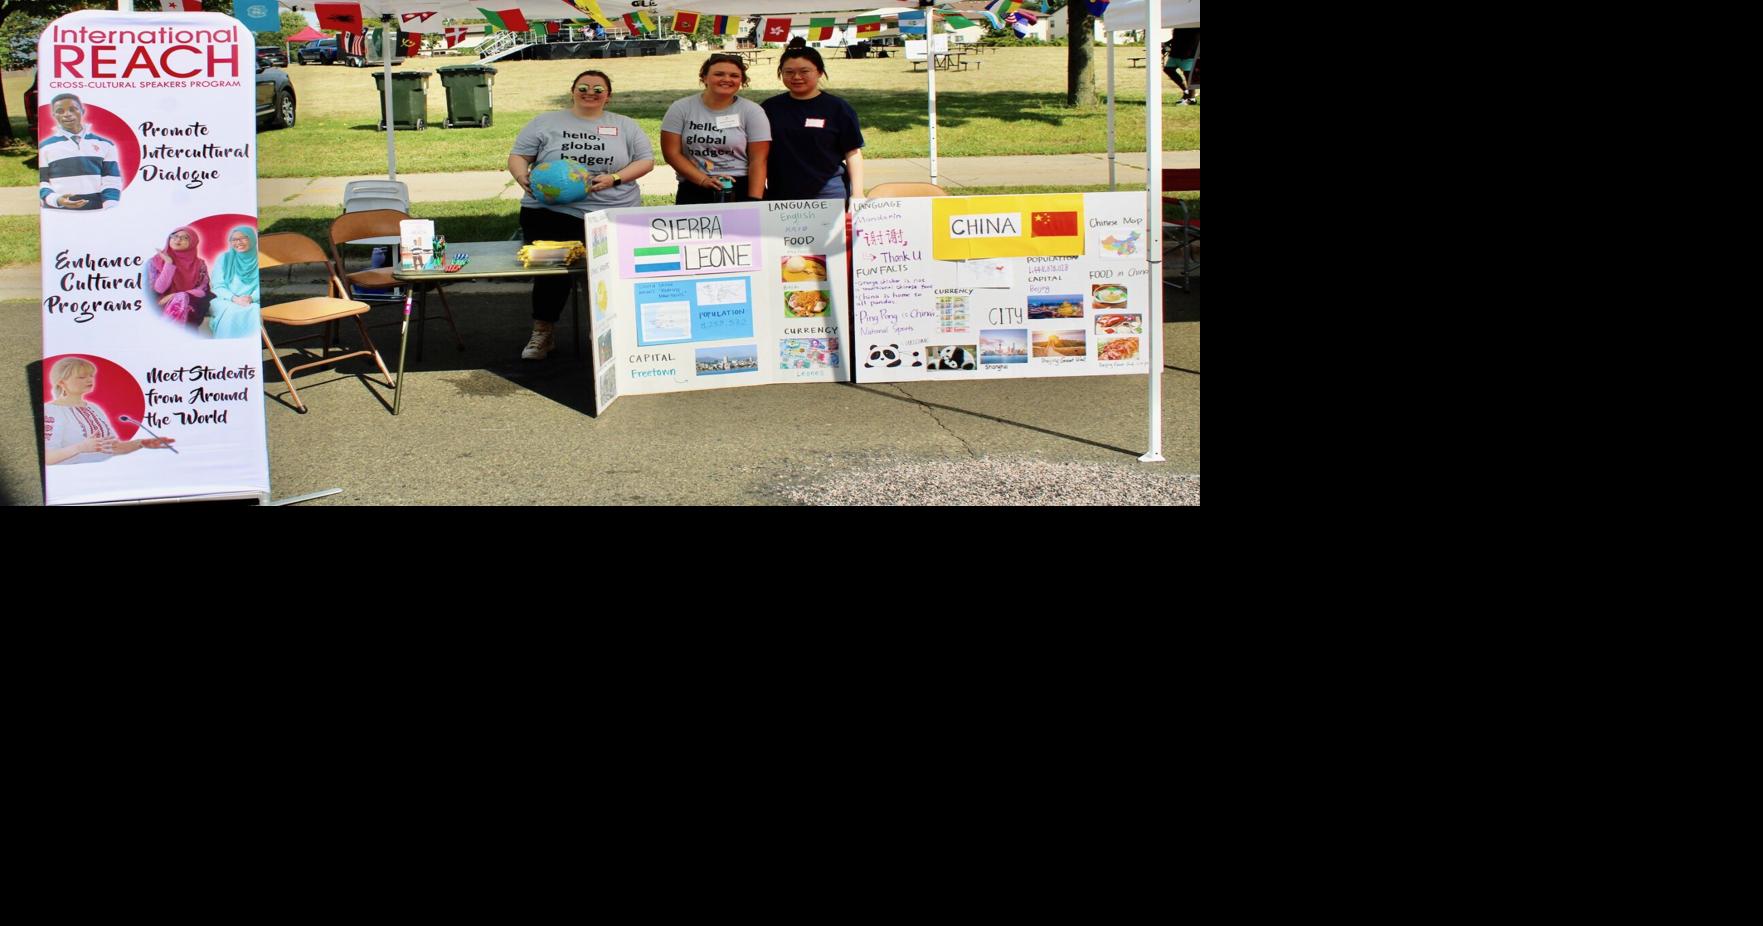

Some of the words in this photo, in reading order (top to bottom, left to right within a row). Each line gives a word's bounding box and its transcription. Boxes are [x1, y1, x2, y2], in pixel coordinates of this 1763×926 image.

[53, 26, 237, 44] International
[53, 45, 239, 78] REACH
[139, 122, 209, 137] Promote
[563, 131, 601, 141] hello,
[561, 142, 605, 151] global
[687, 134, 726, 145] global
[142, 144, 250, 160] Intercultural
[140, 165, 219, 189] Dialogue
[768, 201, 829, 212] LANGUAGE
[853, 200, 903, 212] LANGUAGE
[651, 215, 723, 242] SIERRA
[951, 215, 1017, 236] CHINA
[1089, 217, 1118, 228] Chinese
[1123, 217, 1143, 225] Map
[783, 235, 815, 247] FOOD
[55, 249, 143, 271] Enhance
[684, 243, 752, 271] LEONE
[880, 250, 911, 263] Thank
[912, 250, 922, 261] U
[856, 267, 878, 279] FUN
[880, 265, 909, 275] FACTS
[1089, 269, 1113, 280] FOOD
[60, 272, 143, 292] Cultural
[934, 287, 973, 296] CURRENCY
[44, 295, 143, 323] Programs
[699, 308, 745, 320] POPULATION
[988, 307, 1023, 326] CITY
[784, 326, 839, 335] CURRENCY
[629, 353, 676, 363] CAPITAL
[146, 367, 187, 383] Meet
[188, 364, 256, 381] Students
[631, 368, 676, 379] Freetown
[145, 388, 183, 404] from
[188, 387, 249, 403] Around
[144, 409, 170, 429] the
[173, 409, 227, 426] World
